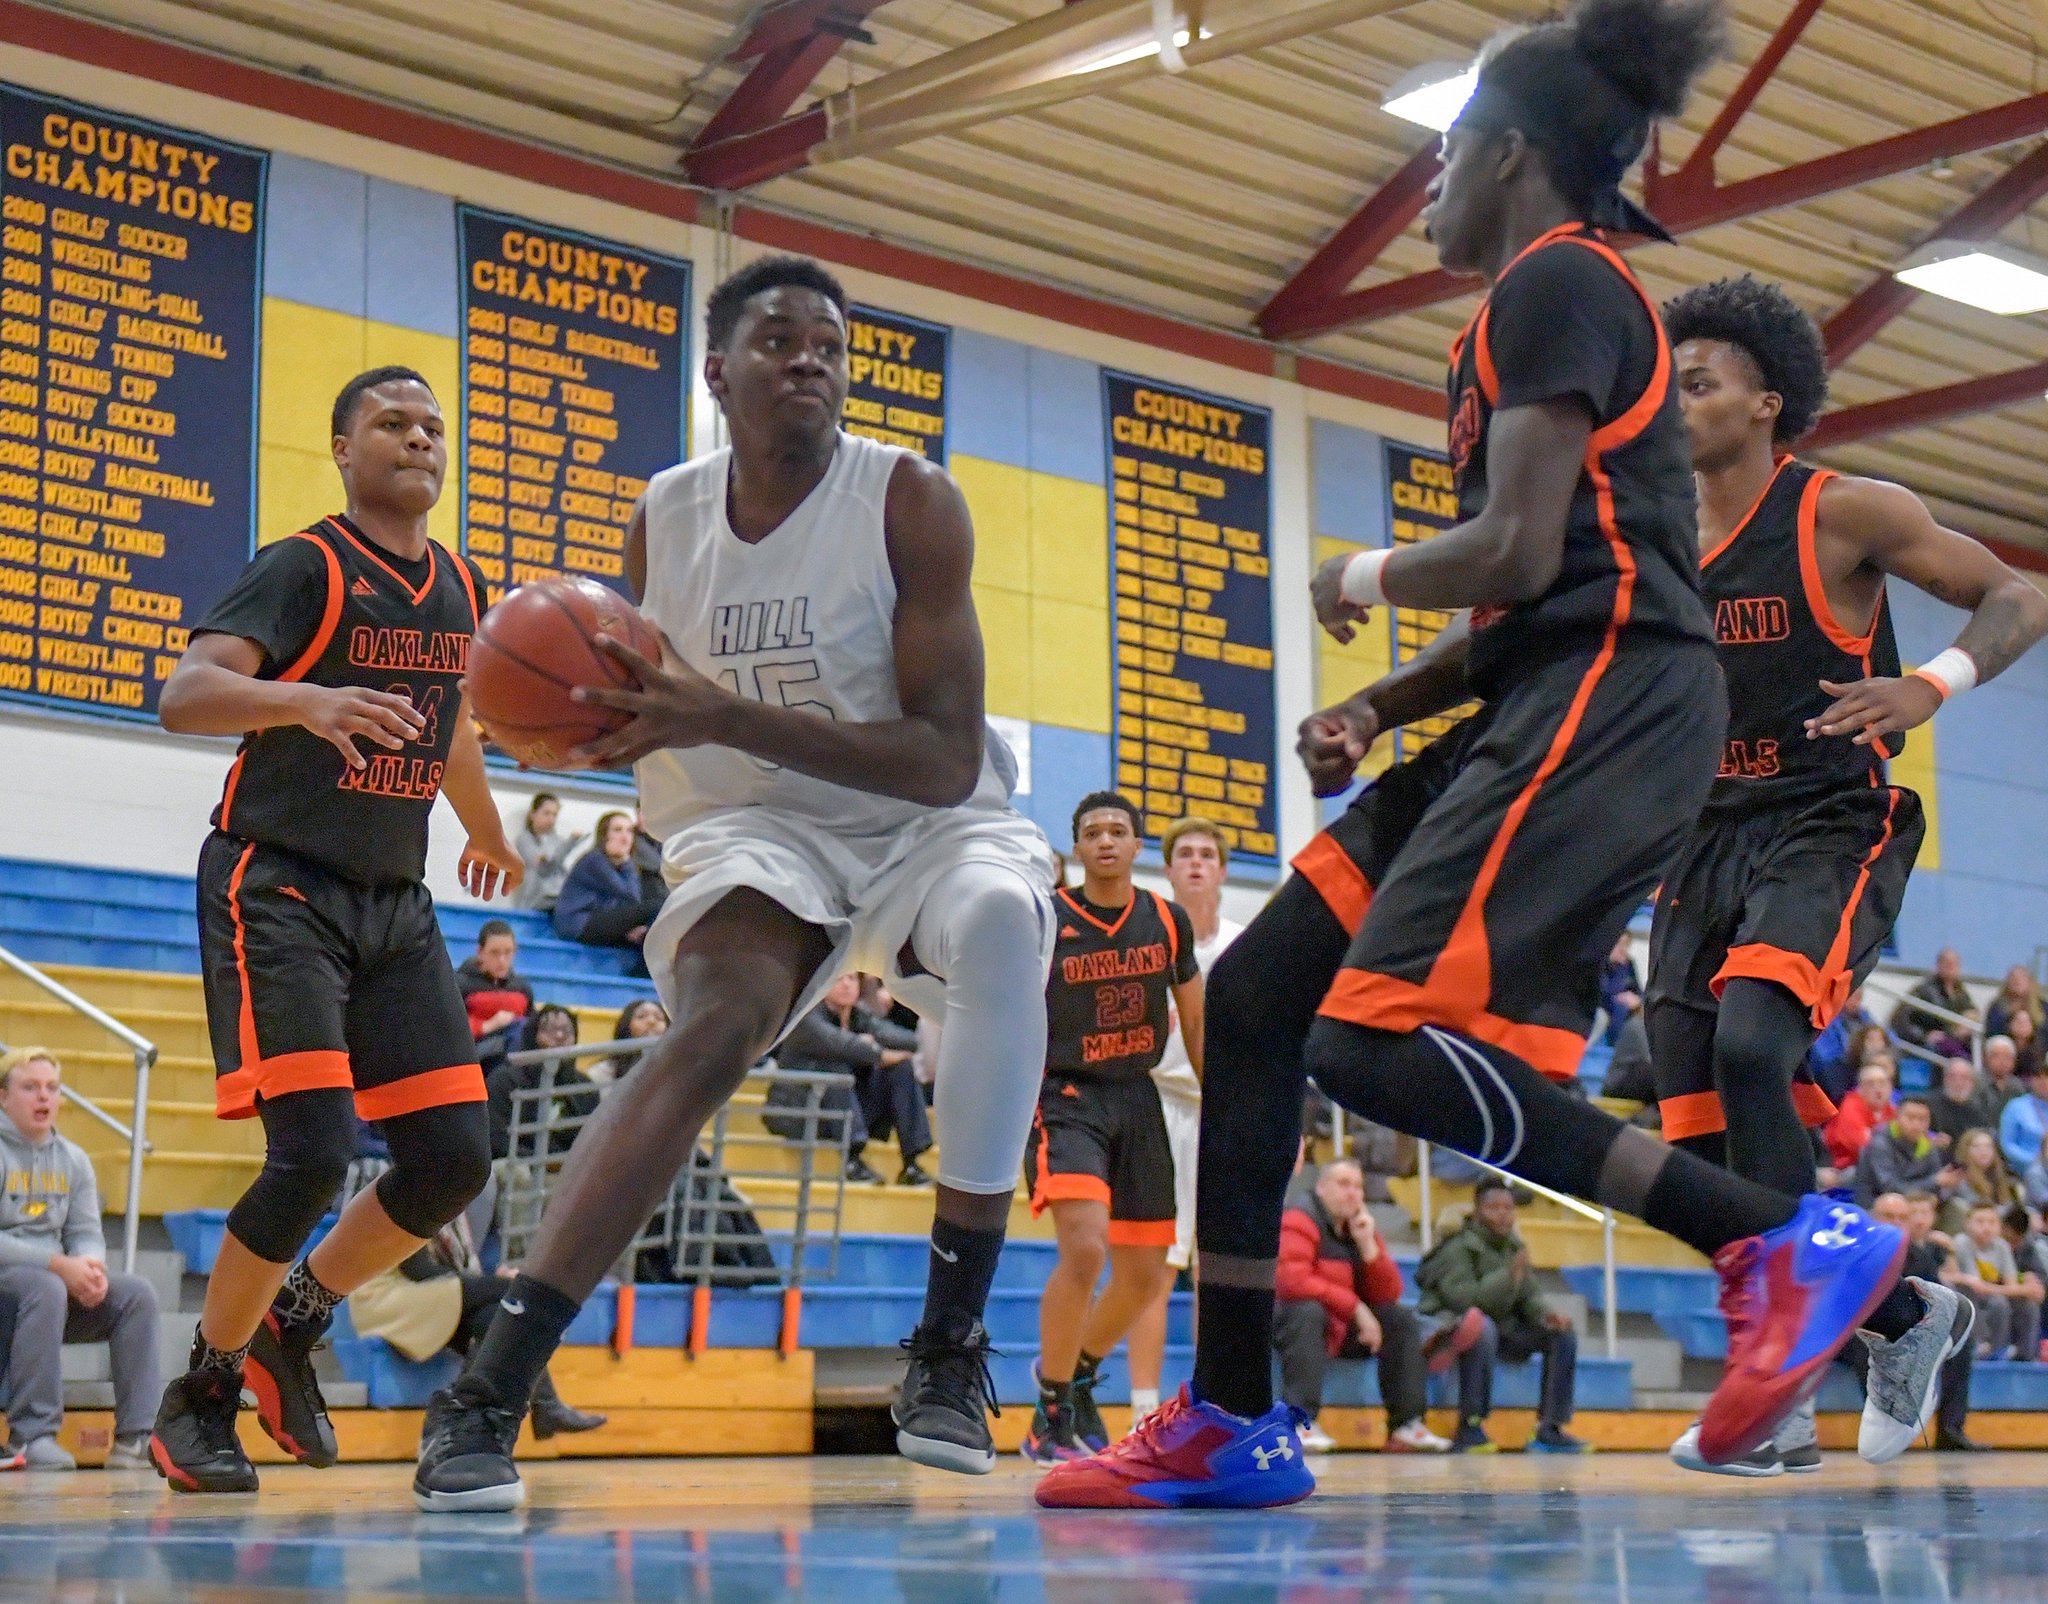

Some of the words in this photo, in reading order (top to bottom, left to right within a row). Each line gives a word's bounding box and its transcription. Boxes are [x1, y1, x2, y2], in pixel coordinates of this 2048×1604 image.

[44, 114, 219, 185] COUNTY
[7, 144, 254, 233] CHAMPIONS
[3, 225, 42, 256] 2001
[51, 237, 151, 283] WRESTLING
[118, 224, 188, 261] SOCCER
[502, 230, 649, 291] COUNTY
[2, 256, 41, 287] 2001
[472, 260, 678, 336] CHAMPIONS
[2, 287, 41, 318] 2001
[117, 314, 227, 360] BASKETBALL
[847, 320, 917, 361] NTY
[1, 318, 40, 348] 2001
[112, 343, 174, 378] TENNIS
[0, 348, 39, 380] 2001
[47, 359, 112, 395] TENNIS
[120, 375, 157, 402] CUP
[847, 353, 942, 400] PIONS
[0, 378, 39, 409] 2001
[107, 402, 175, 437] SOCCER
[1134, 389, 1242, 438] COUNTY
[0, 409, 39, 440] 2001
[45, 418, 160, 465] VOLLEYBALL
[1113, 416, 1264, 474] CHAMPIONS
[43, 480, 142, 522] WRESTLING
[105, 462, 215, 507] BASKETBALL
[102, 522, 165, 559] TENNIS
[564, 518, 625, 550] SOCCER
[39, 542, 132, 583] SOFTBALL
[563, 545, 624, 578] SOCCER
[110, 586, 182, 621] SOCCER
[710, 596, 813, 656] HILL
[103, 615, 163, 649] CROSS
[38, 636, 144, 677] WRESTLING
[37, 667, 143, 707] WRESTLING
[1063, 944, 1168, 985] OAKLAND
[1096, 982, 1145, 1029] 23
[1082, 1025, 1155, 1063] MILLS
